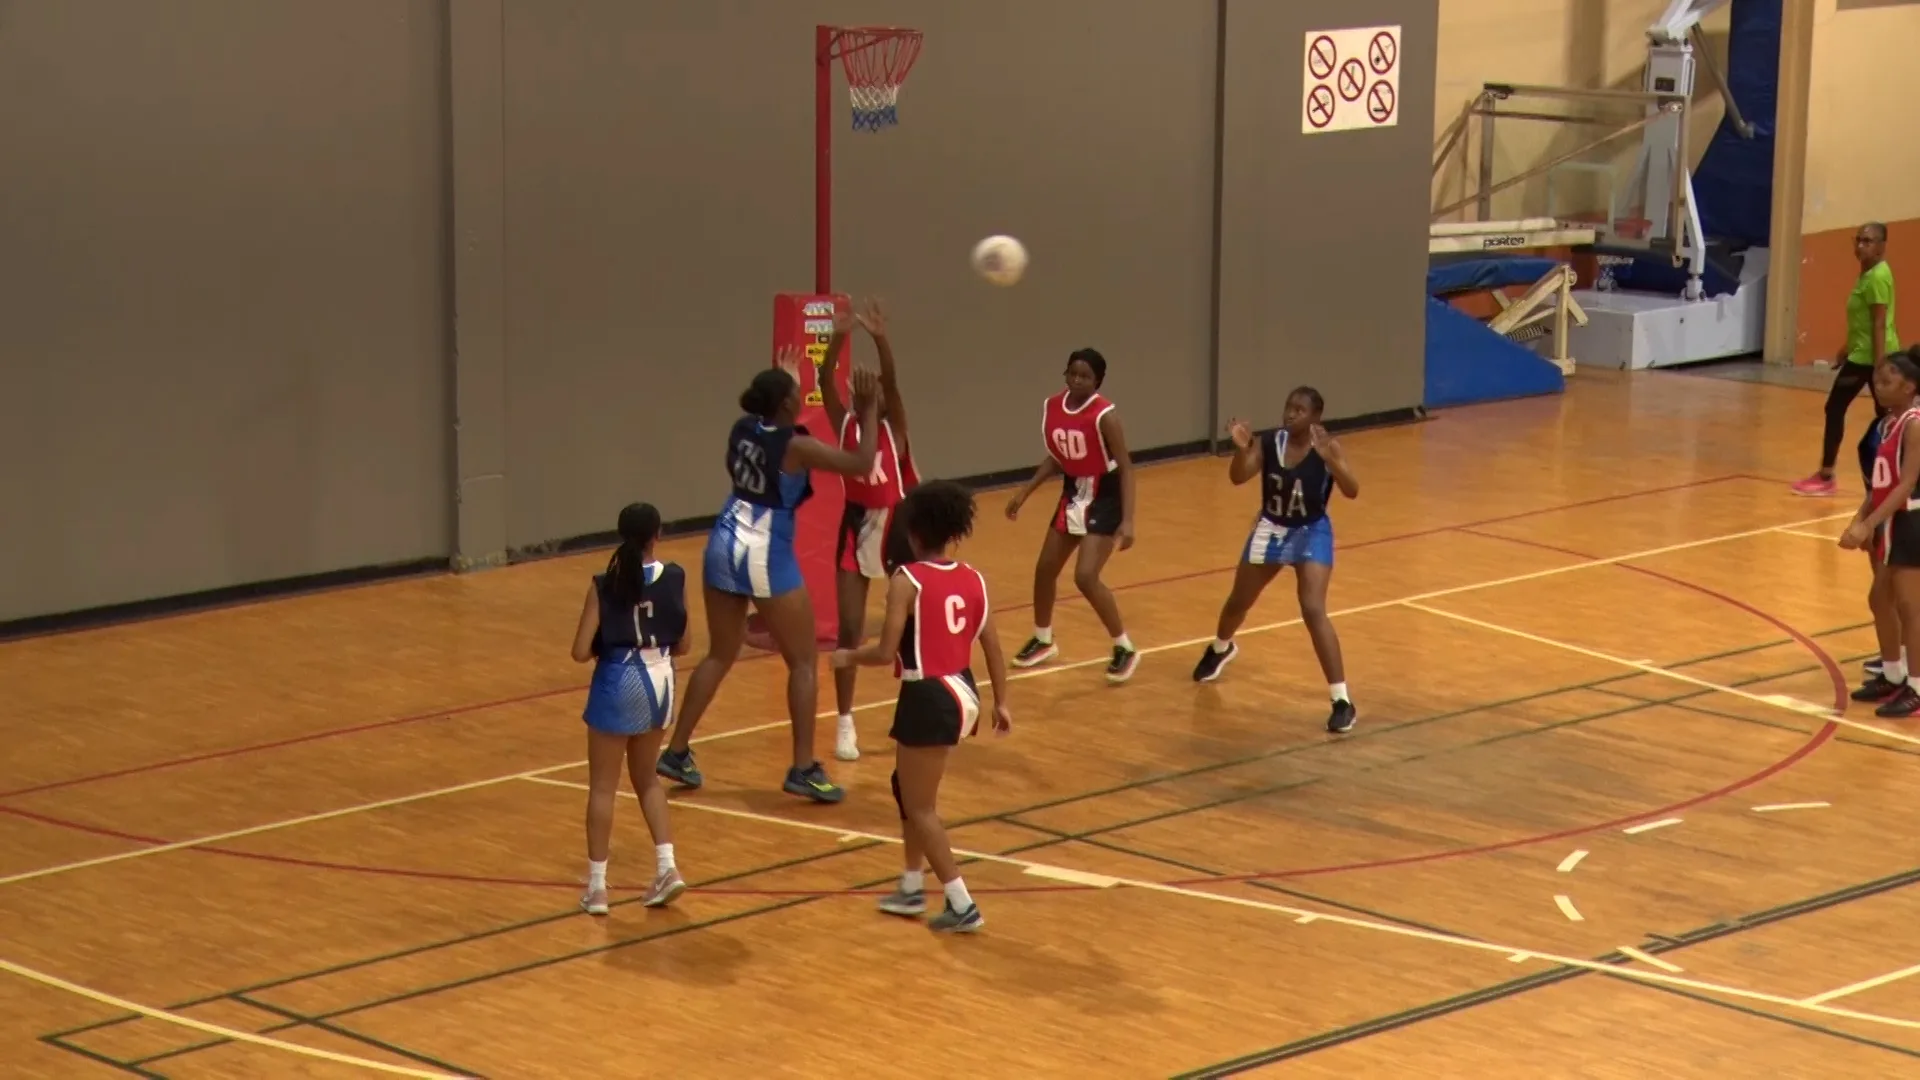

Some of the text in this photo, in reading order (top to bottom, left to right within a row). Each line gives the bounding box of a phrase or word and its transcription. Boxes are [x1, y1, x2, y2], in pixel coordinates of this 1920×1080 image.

[1052, 427, 1088, 460] GD
[734, 439, 767, 494] GS
[944, 594, 967, 635] C
